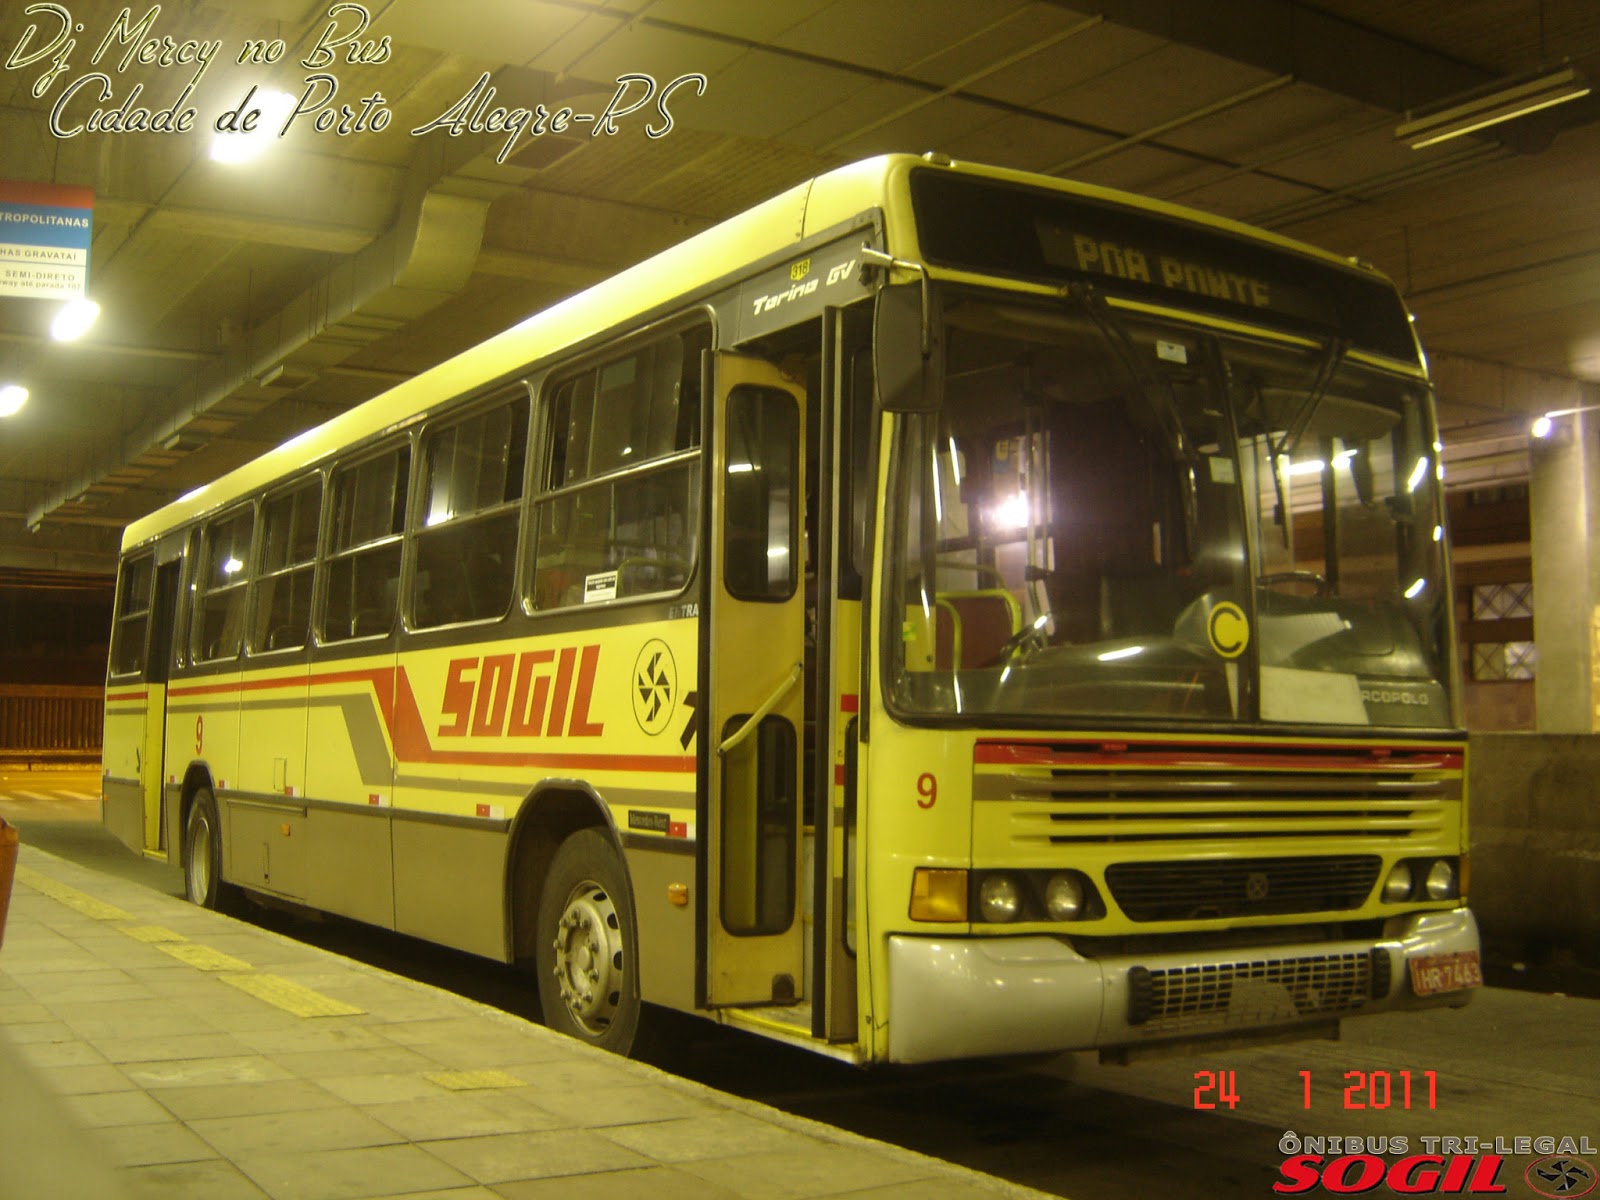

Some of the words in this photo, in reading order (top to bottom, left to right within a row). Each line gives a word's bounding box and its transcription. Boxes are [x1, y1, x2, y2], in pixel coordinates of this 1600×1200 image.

[5, 270, 75, 282] SEMI-DIRETO
[753, 278, 819, 316] Torino
[826, 259, 856, 287] GV
[791, 262, 810, 279] 318
[437, 644, 604, 737] SOGIL
[195, 714, 204, 756] 9
[916, 772, 937, 810] 9
